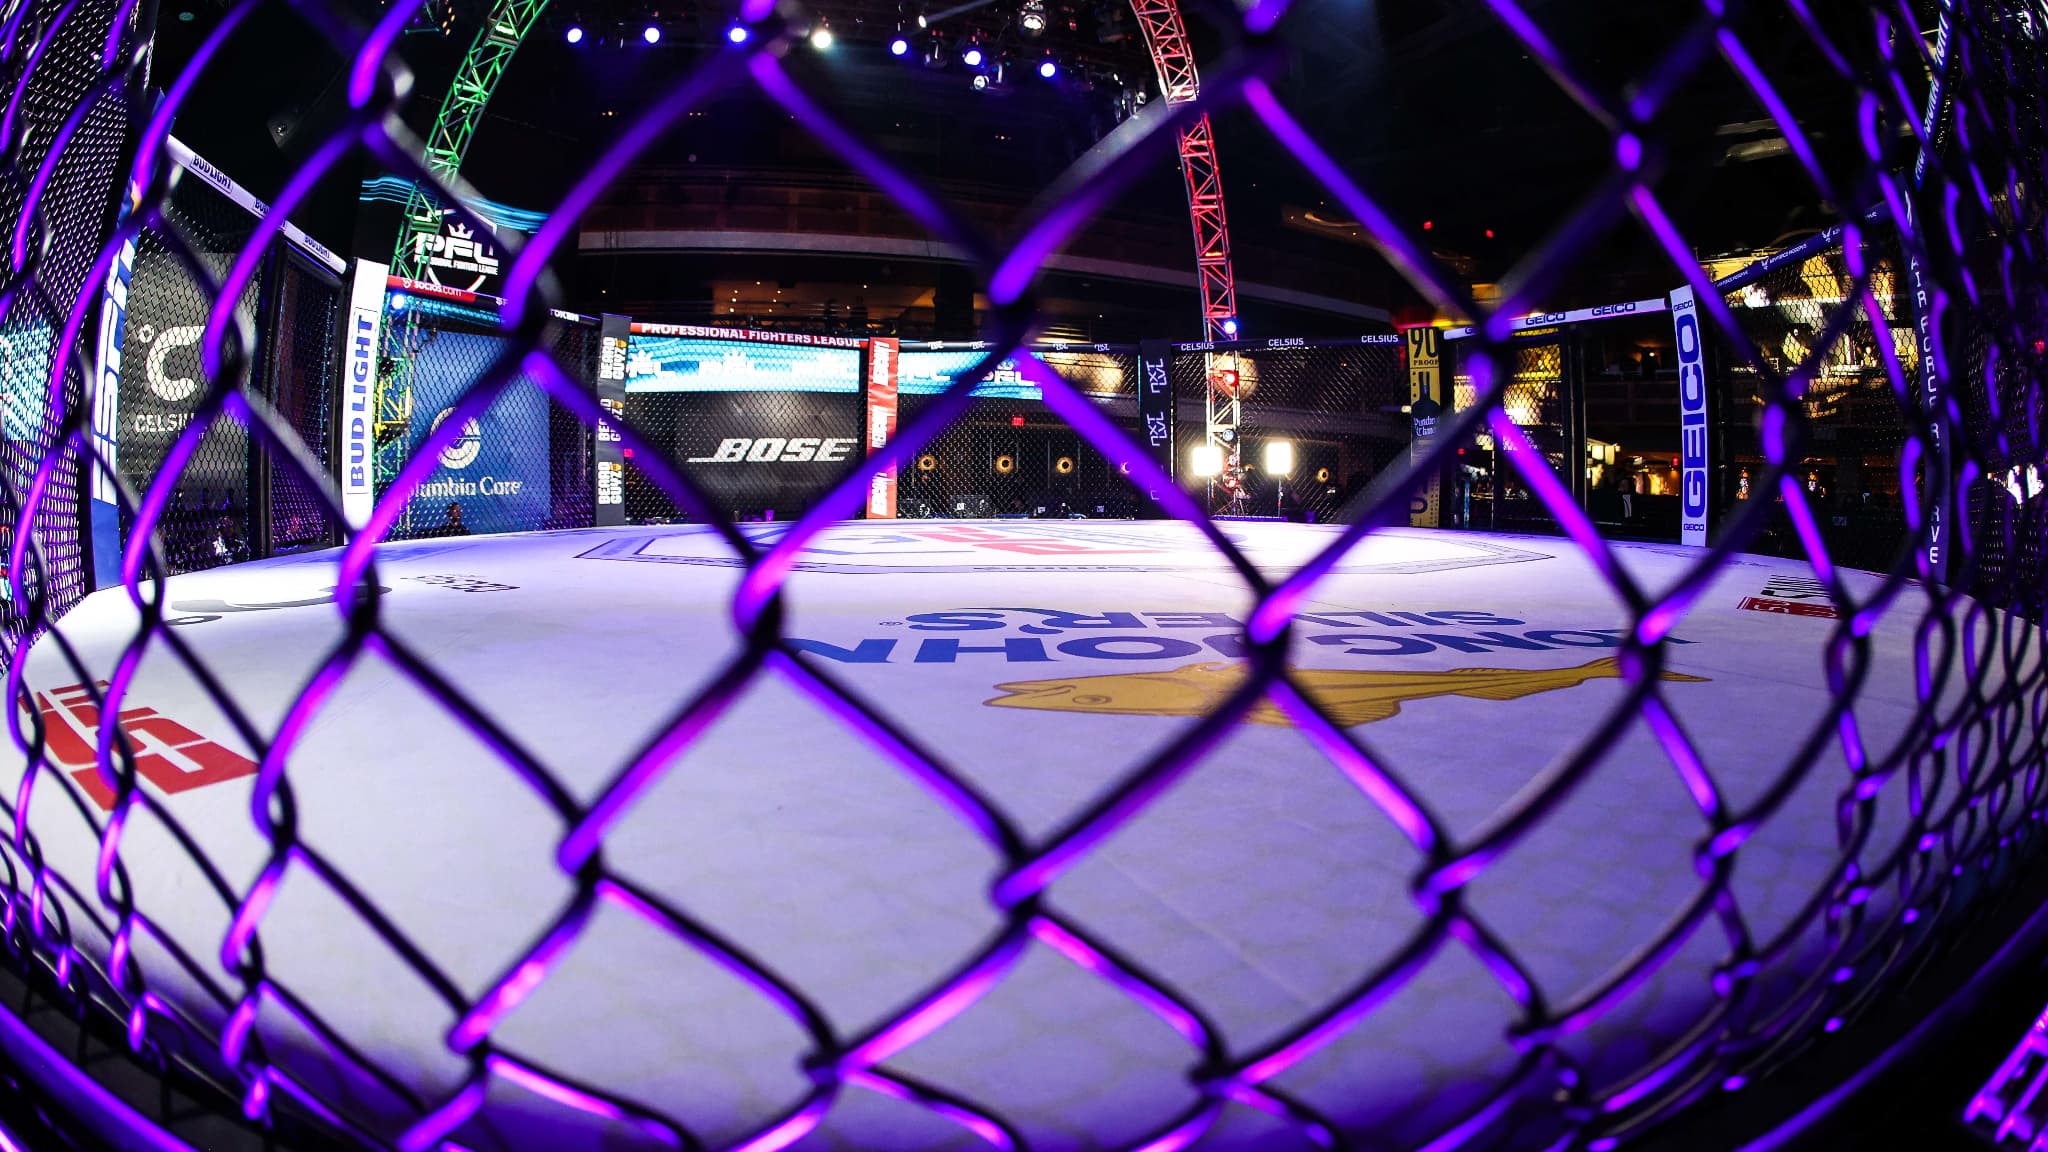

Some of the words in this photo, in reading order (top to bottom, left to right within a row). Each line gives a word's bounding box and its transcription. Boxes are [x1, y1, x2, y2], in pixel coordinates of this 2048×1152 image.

[415, 232, 499, 267] PFL
[1910, 255, 1927, 309] AIR
[1526, 311, 1566, 327] GEICO
[1592, 302, 1636, 317] GEICO
[1673, 299, 1694, 312] GEICO
[641, 323, 747, 340] PROFESSIONAL
[749, 331, 812, 345] FIGHTERS
[813, 337, 861, 348] LEAGUE
[1180, 342, 1215, 352] CELSIUS
[1268, 338, 1305, 348] CELSIUS
[1361, 334, 1399, 344] CELSIUS
[1410, 327, 1439, 358] 90
[93, 236, 138, 506] ESPN
[351, 314, 373, 412] LIGHT
[600, 336, 617, 380] BEARD
[612, 346, 626, 381] GUYZ
[1676, 313, 1706, 519] GEICO
[350, 420, 366, 487] BUD
[686, 437, 859, 464] BOSE
[408, 476, 477, 498] lumbia
[479, 476, 521, 496] Care
[598, 461, 611, 505] BEARD
[610, 470, 623, 505] GUYZ
[1683, 523, 1705, 532] GEICO
